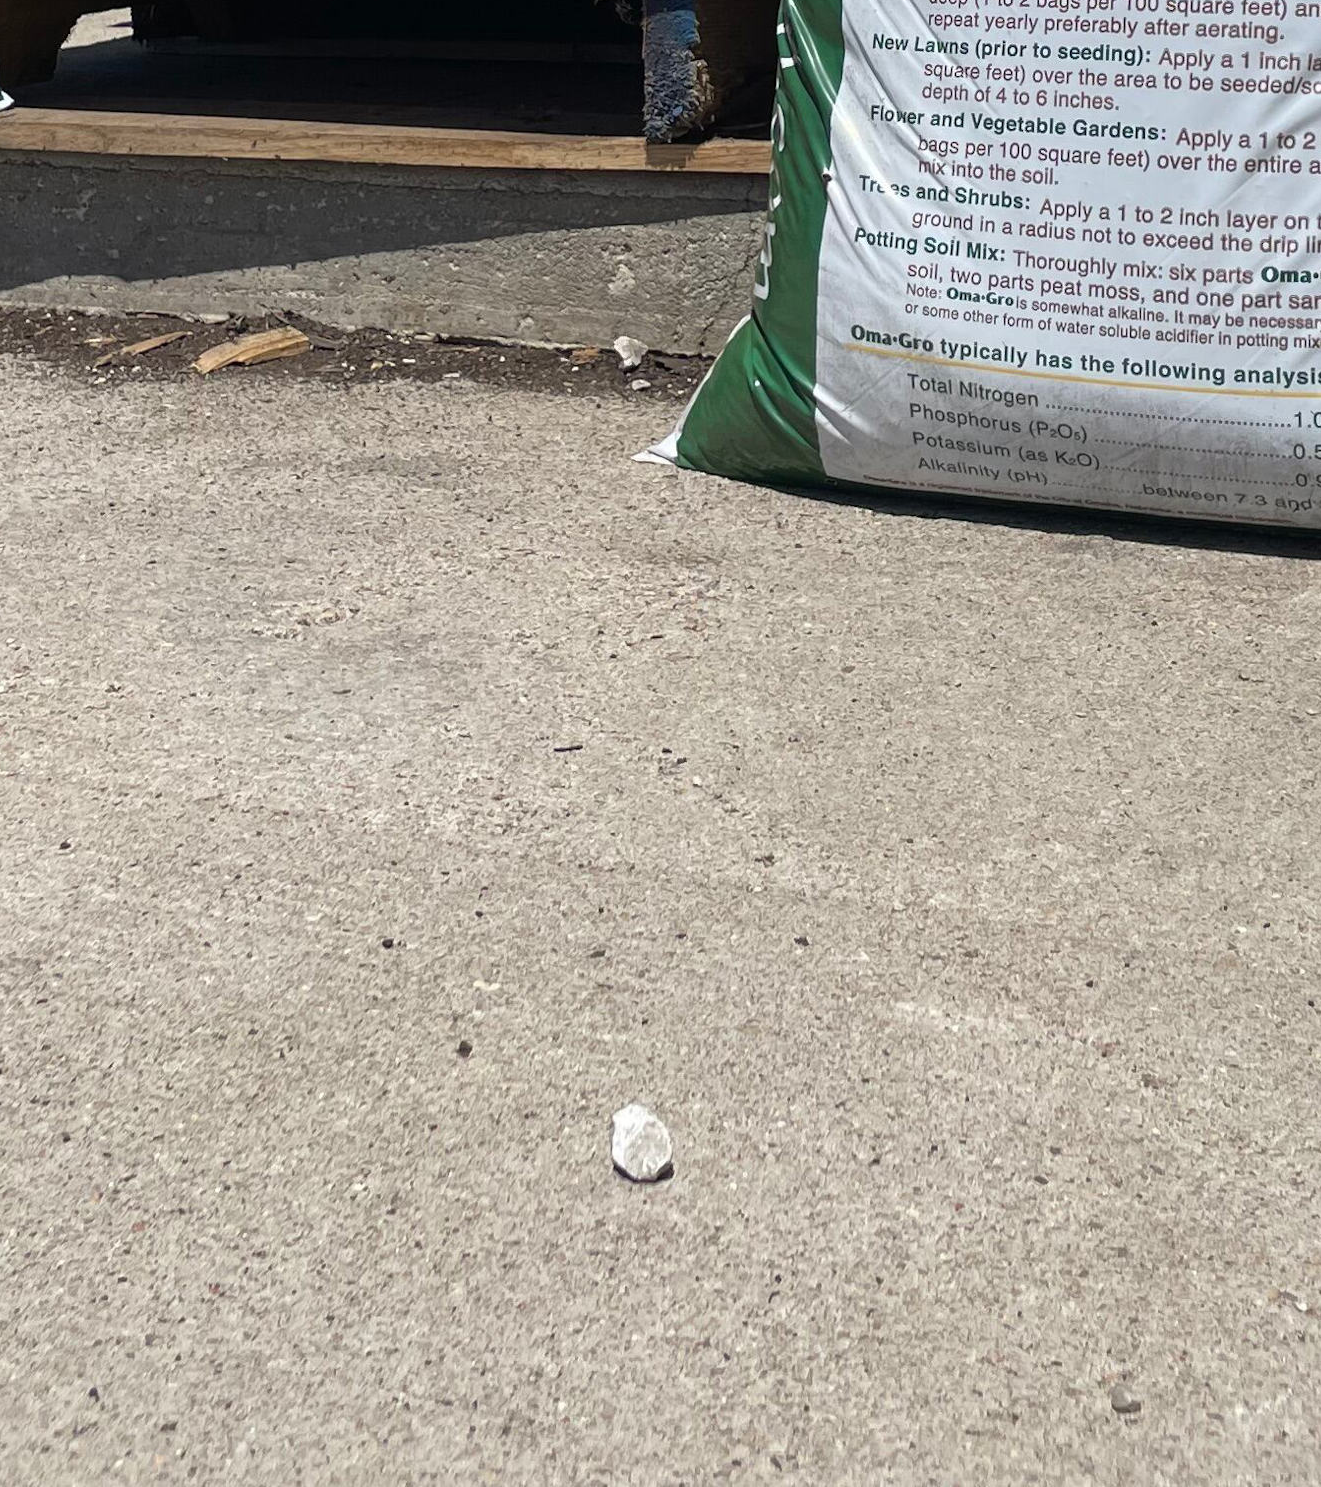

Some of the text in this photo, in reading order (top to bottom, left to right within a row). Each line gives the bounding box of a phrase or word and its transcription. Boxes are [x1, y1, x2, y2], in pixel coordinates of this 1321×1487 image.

[928, 12, 1285, 44] repeat yearly preferably after aerating.
[872, 34, 908, 52] New
[914, 37, 969, 54] Lawns
[976, 39, 1027, 60] (prior
[1032, 42, 1051, 59] to
[1058, 45, 1151, 67] seeding):
[1159, 48, 1215, 72] Apply
[1221, 54, 1233, 69] a
[1241, 53, 1249, 68] 1
[1260, 53, 1301, 71] inch
[922, 85, 1120, 111] depth of 4 to 6 inches.
[918, 160, 1059, 186] mix into the soil.
[940, 337, 1028, 368] typically
[1036, 348, 1073, 371] has
[1080, 353, 1115, 374] the
[1121, 358, 1226, 386] following
[907, 372, 952, 395] Total
[959, 376, 1039, 408] Nitrogen
[909, 403, 1021, 434] Phosphorus
[912, 432, 1012, 459] Potassium
[1018, 447, 1048, 464] (as
[918, 456, 1000, 481] Alkalinity
[1007, 468, 1048, 486] (pH)
[1142, 483, 1229, 505] between
[1275, 495, 1312, 514] and
